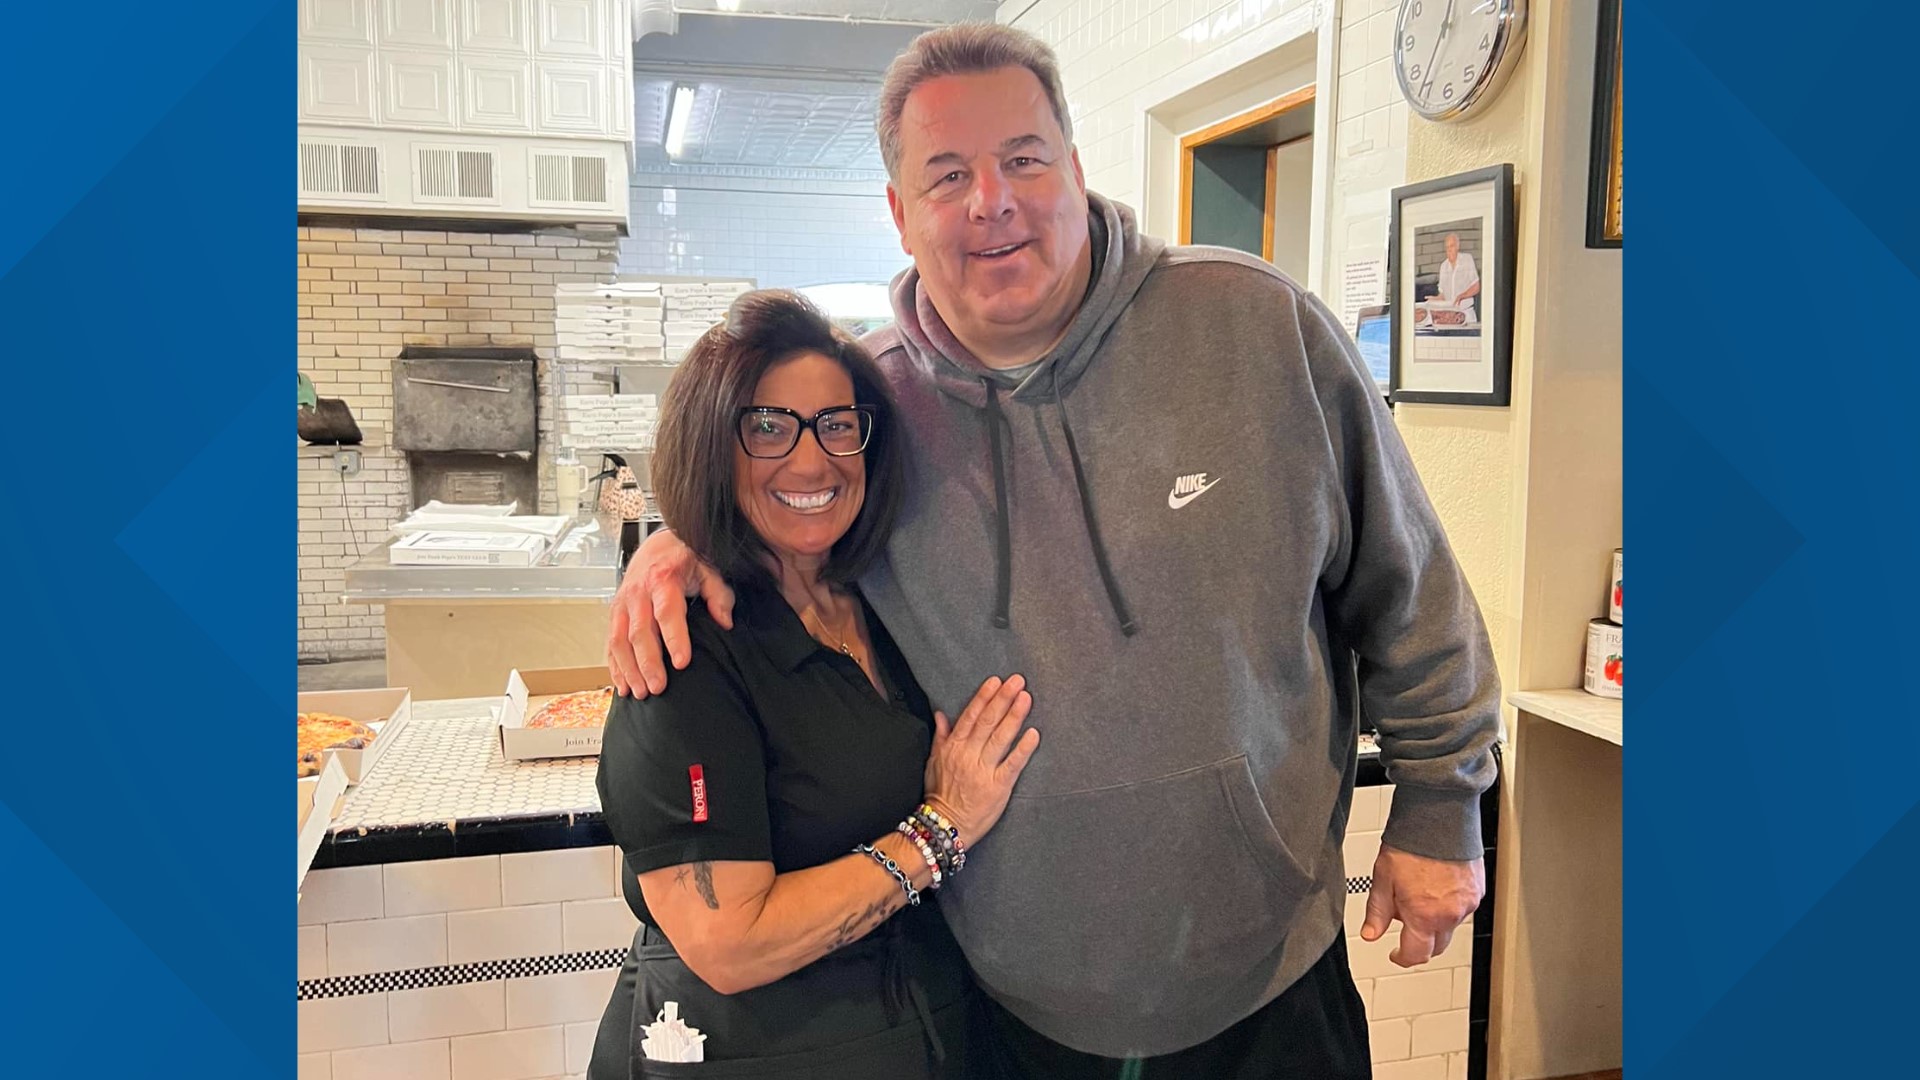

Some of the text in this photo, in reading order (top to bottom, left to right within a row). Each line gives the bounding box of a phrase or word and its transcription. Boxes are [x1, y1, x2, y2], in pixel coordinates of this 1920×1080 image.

[1411, 1, 1422, 20] 10
[1405, 35, 1415, 52] 9
[1479, 33, 1490, 51] 4
[1410, 64, 1421, 80] 8
[1463, 64, 1475, 83] 5
[1423, 81, 1433, 99] 7
[1442, 82, 1454, 99] 6
[1175, 473, 1207, 495] NIKE
[565, 737, 584, 748] Join
